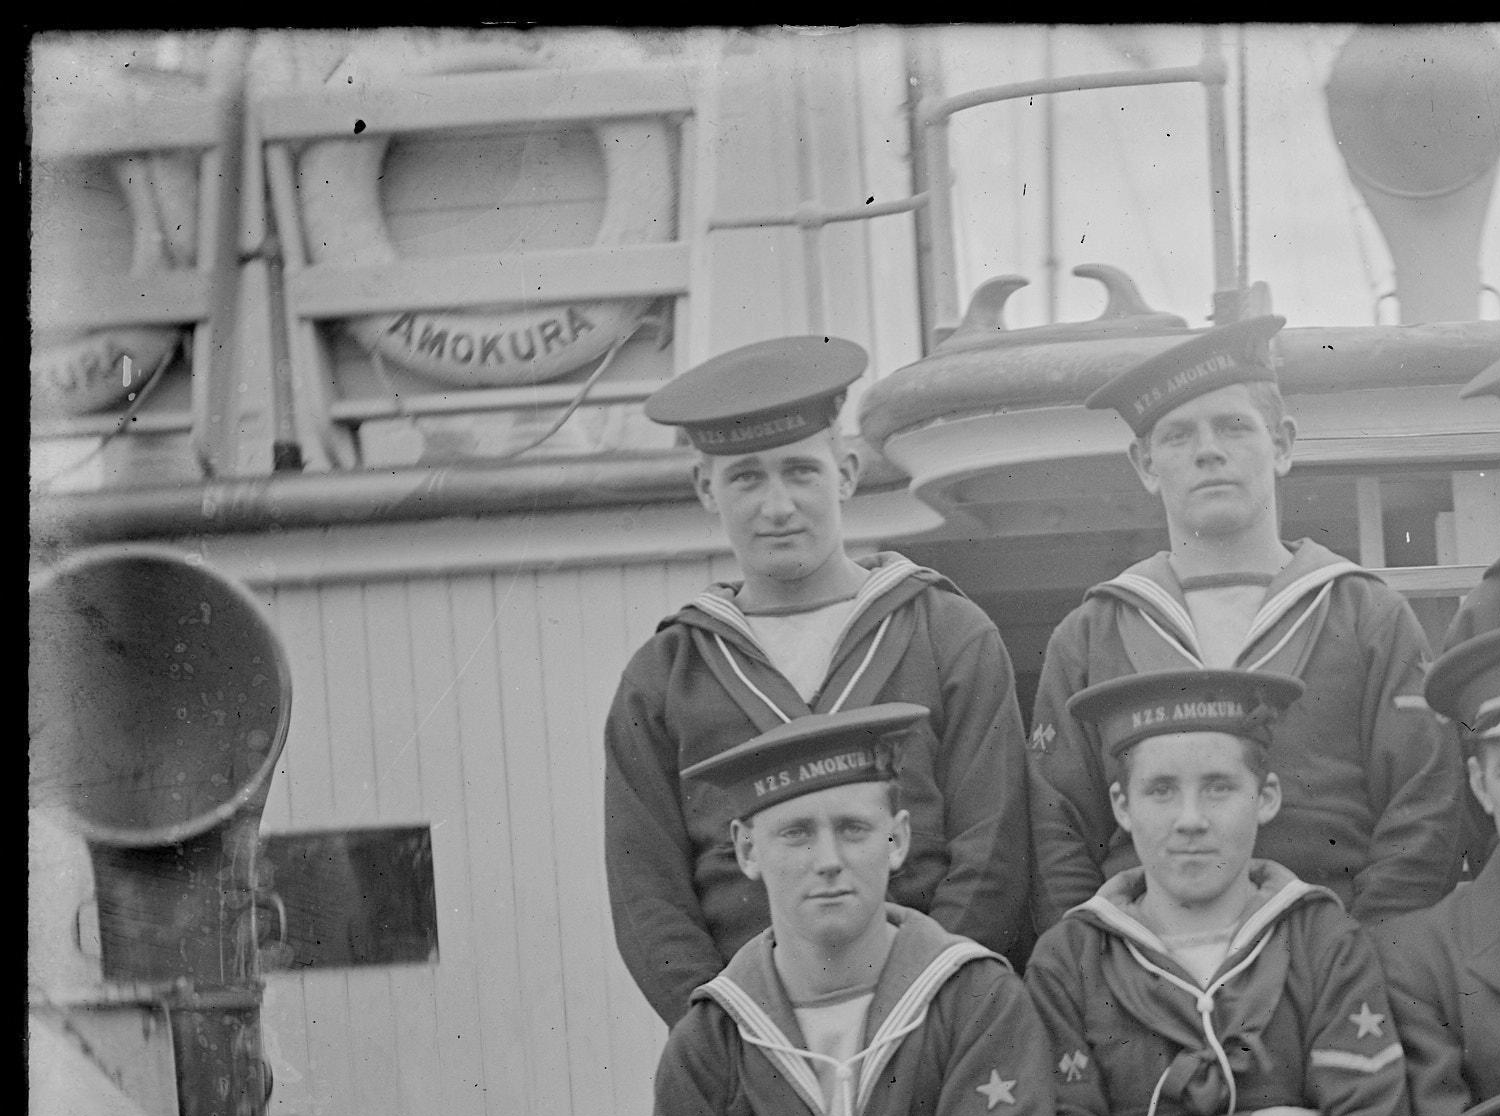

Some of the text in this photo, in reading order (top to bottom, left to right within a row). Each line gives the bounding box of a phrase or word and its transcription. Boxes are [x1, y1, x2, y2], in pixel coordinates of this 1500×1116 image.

[386, 306, 596, 365] AMOKURA
[1167, 353, 1236, 393] AMOKURA
[1172, 700, 1245, 721] AMOKURA
